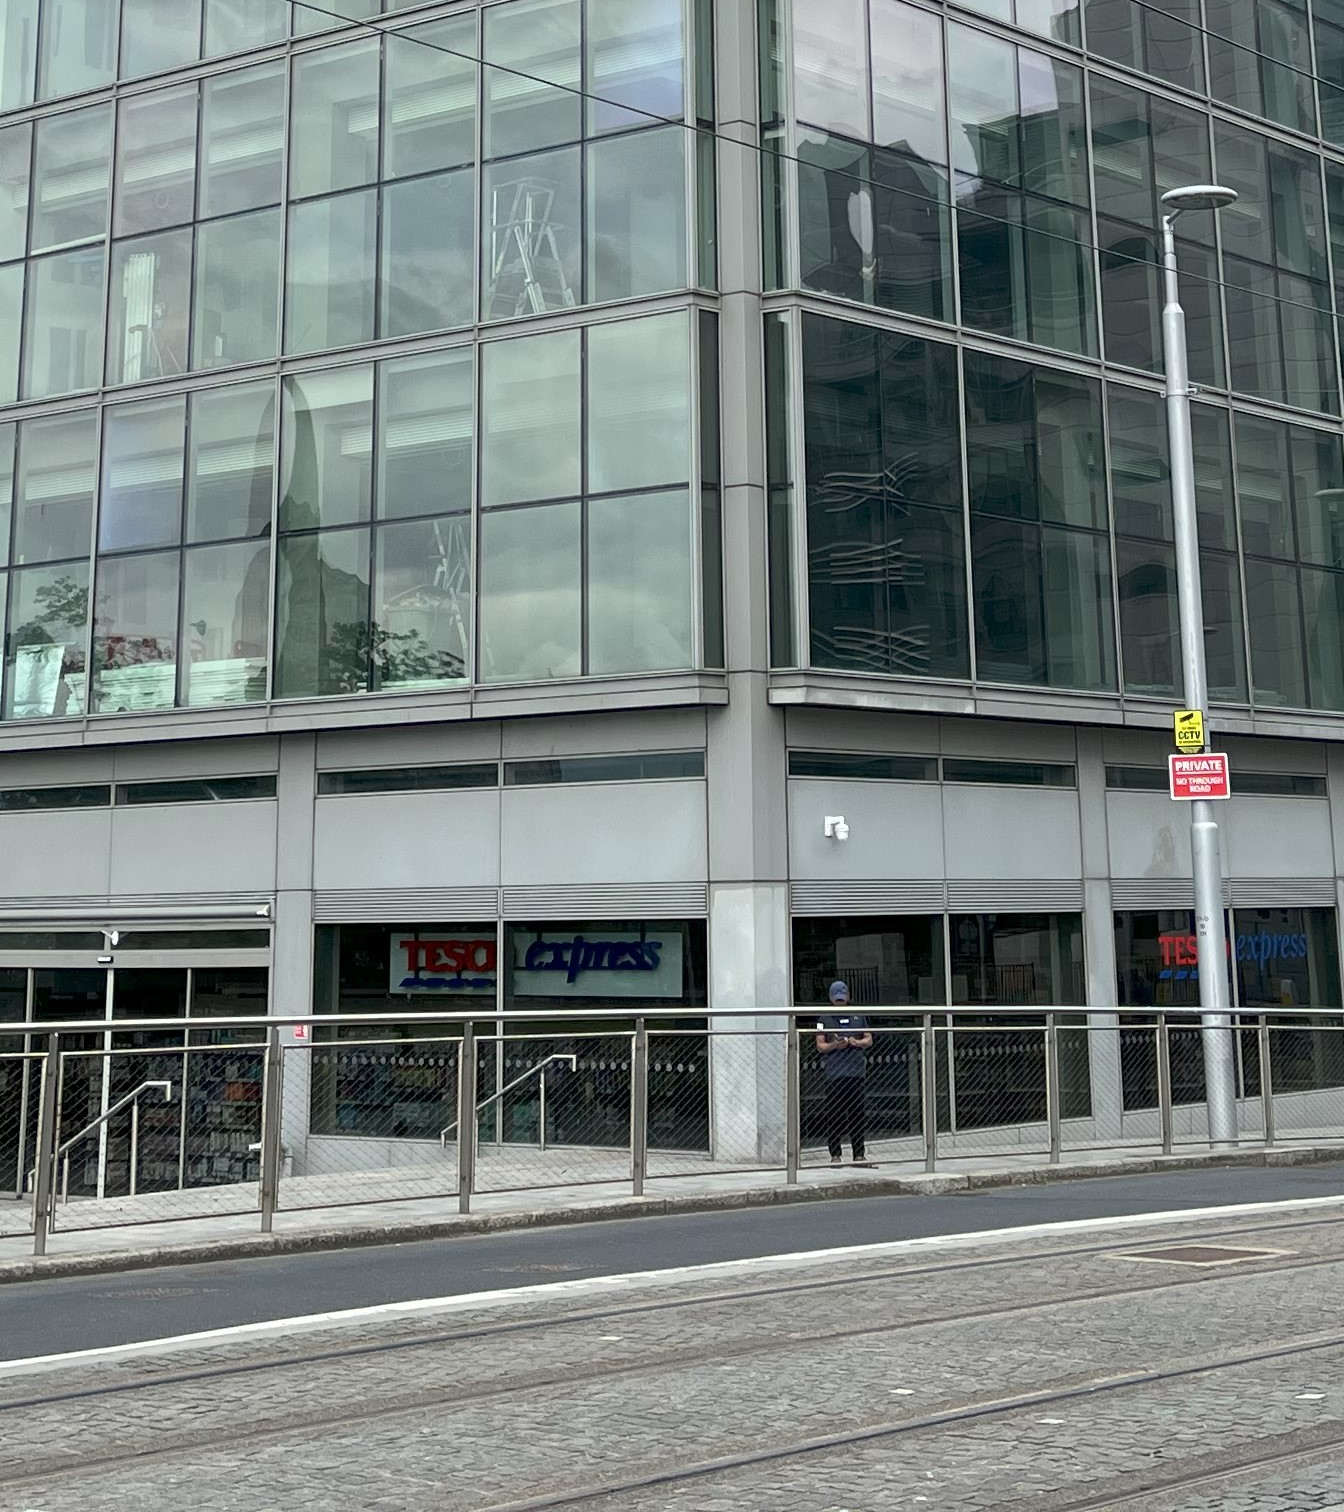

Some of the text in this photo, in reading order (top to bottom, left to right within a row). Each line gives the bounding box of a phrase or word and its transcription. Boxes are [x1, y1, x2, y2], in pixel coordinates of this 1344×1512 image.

[1178, 730, 1201, 740] CCTV
[1175, 760, 1223, 771] PRIVATE
[1176, 776, 1224, 786] NO THROUGH
[1189, 785, 1212, 794] ROAD
[1236, 931, 1308, 971] express
